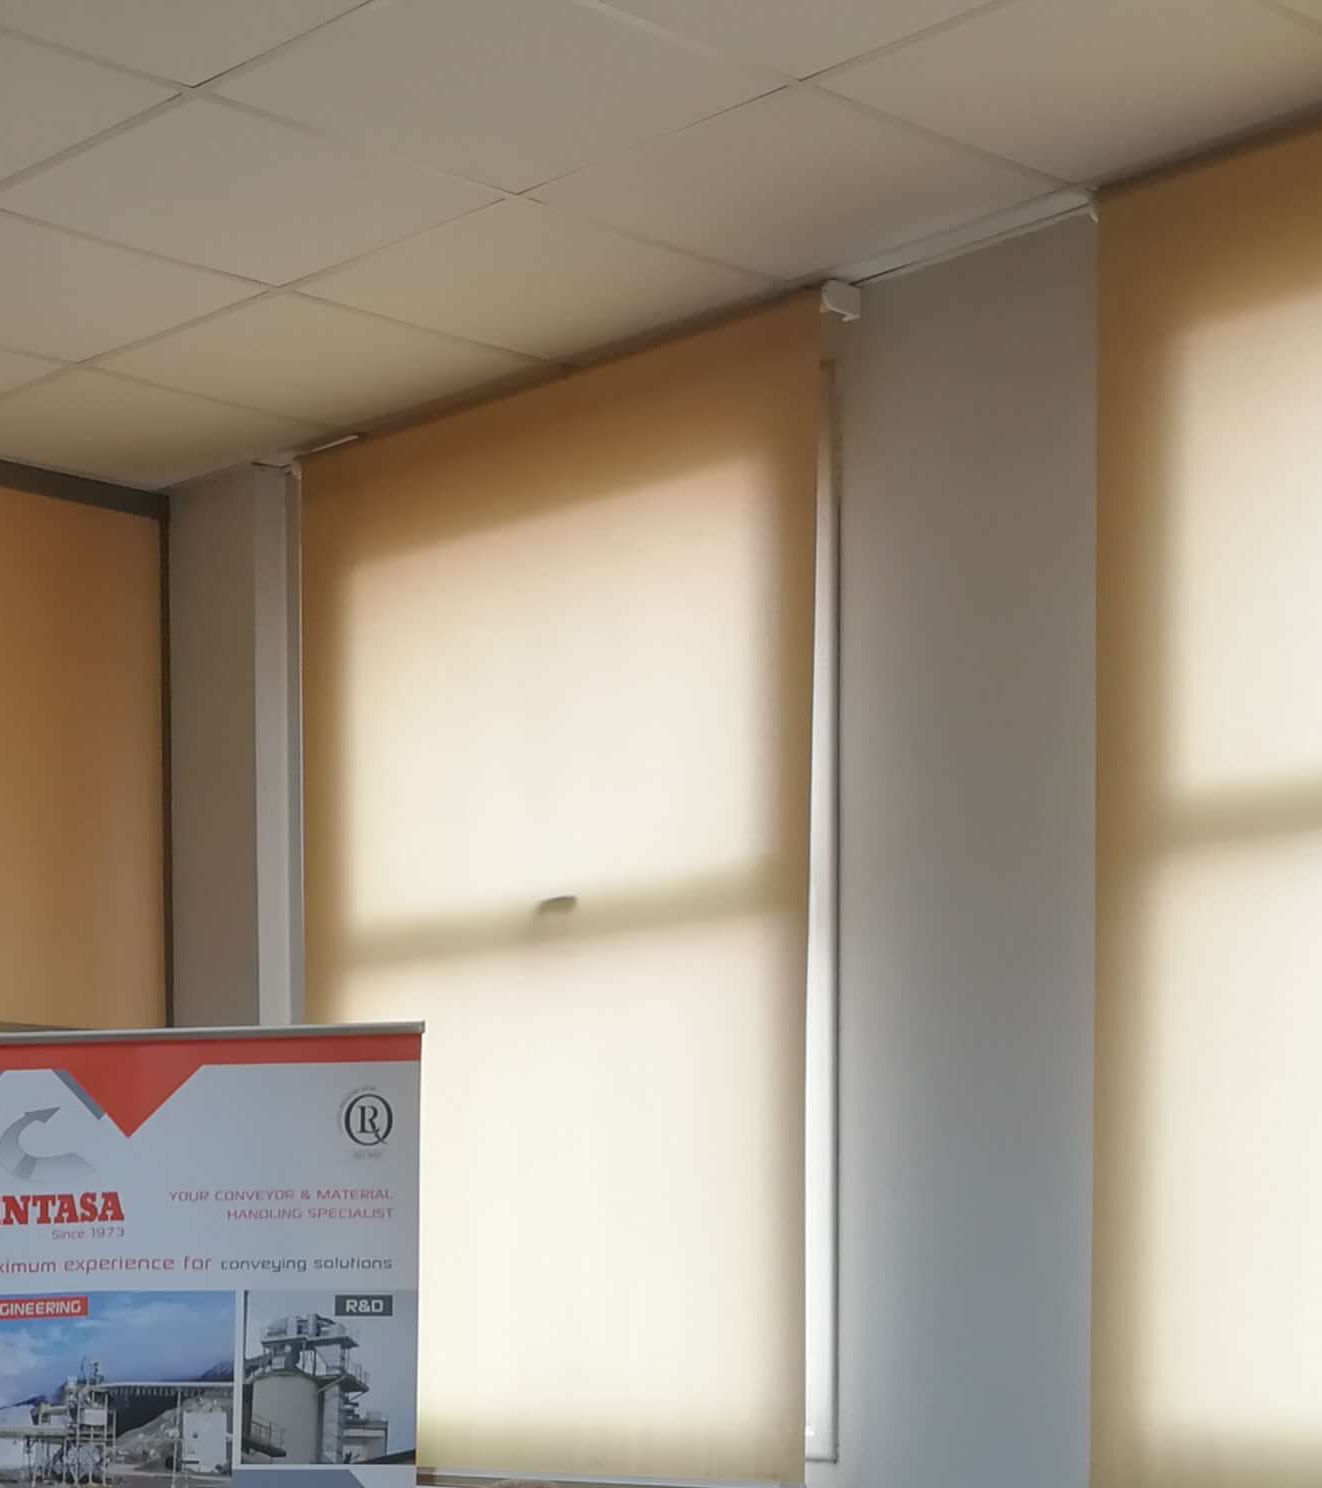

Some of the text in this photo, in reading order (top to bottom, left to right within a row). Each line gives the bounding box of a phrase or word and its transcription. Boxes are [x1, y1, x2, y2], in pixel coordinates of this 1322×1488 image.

[169, 1188, 393, 1202] YOUR CONVEYOR & MATERIAL
[227, 1207, 393, 1220] HANDLING SPECIALIST
[52, 1227, 125, 1240] Since 1973
[64, 1254, 174, 1275] experience
[183, 1255, 211, 1270] for
[221, 1257, 307, 1272] conveying
[314, 1256, 392, 1269] solutions
[345, 1299, 383, 1313] R&D
